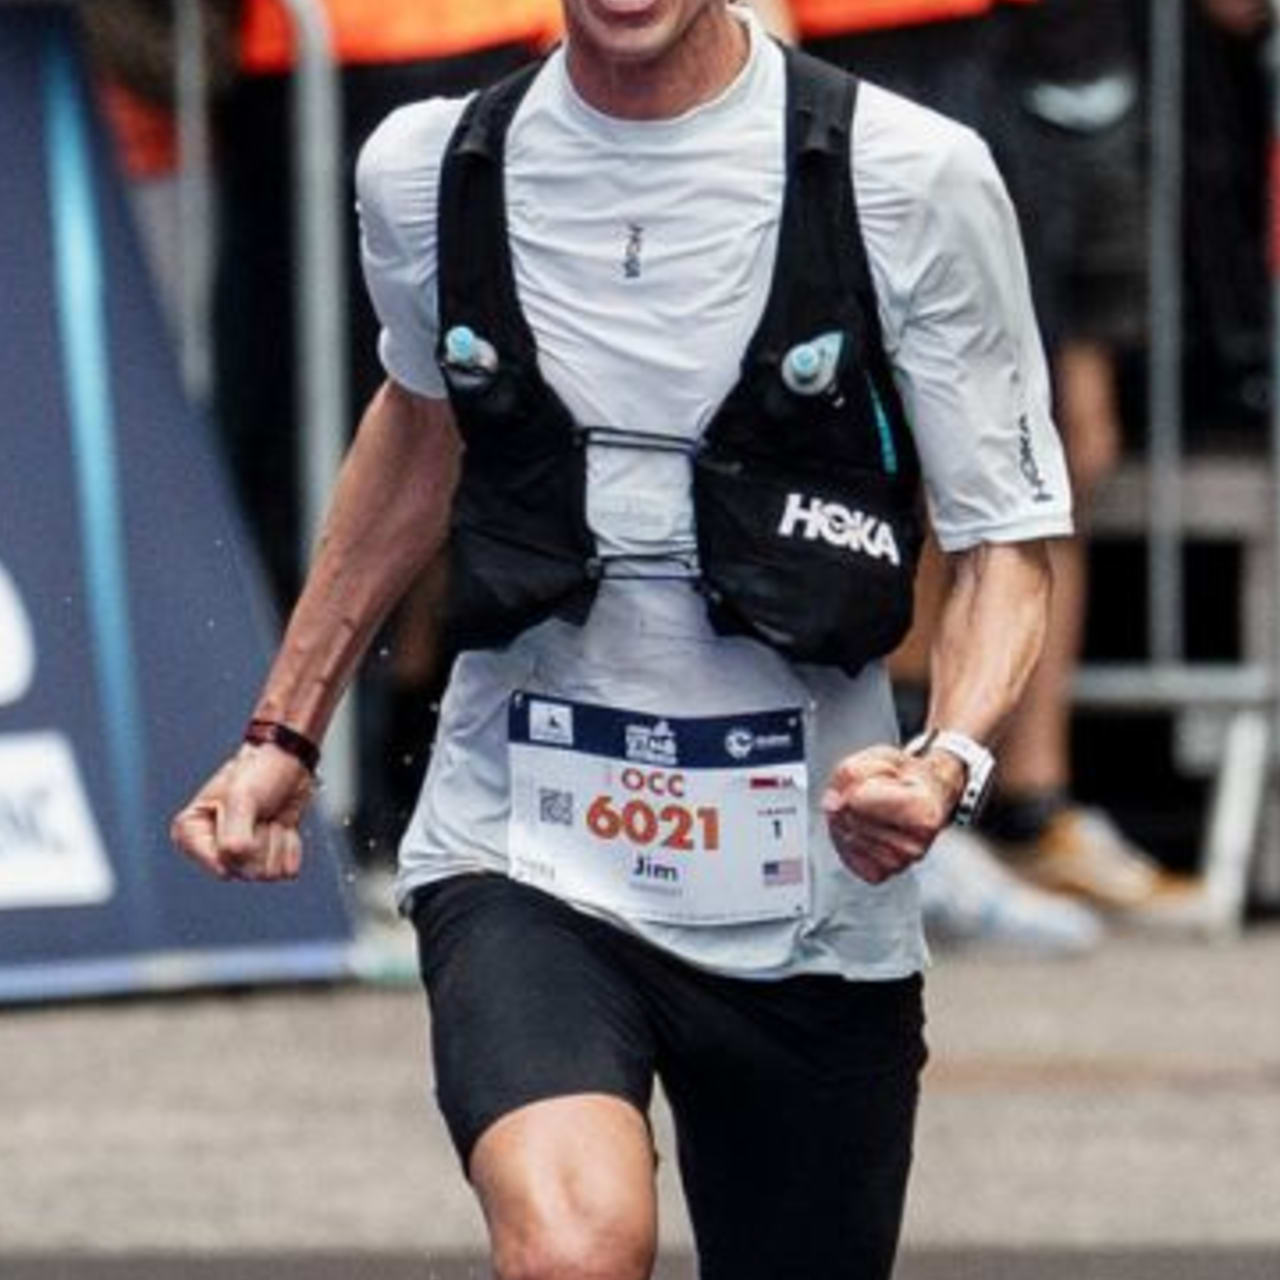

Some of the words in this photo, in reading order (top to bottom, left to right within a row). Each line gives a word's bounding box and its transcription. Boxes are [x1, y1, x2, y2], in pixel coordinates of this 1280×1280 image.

[1018, 413, 1053, 503] HOKA
[778, 492, 900, 567] HOKA
[621, 767, 685, 798] OCC
[587, 795, 719, 851] 6021
[633, 855, 679, 881] Jim
